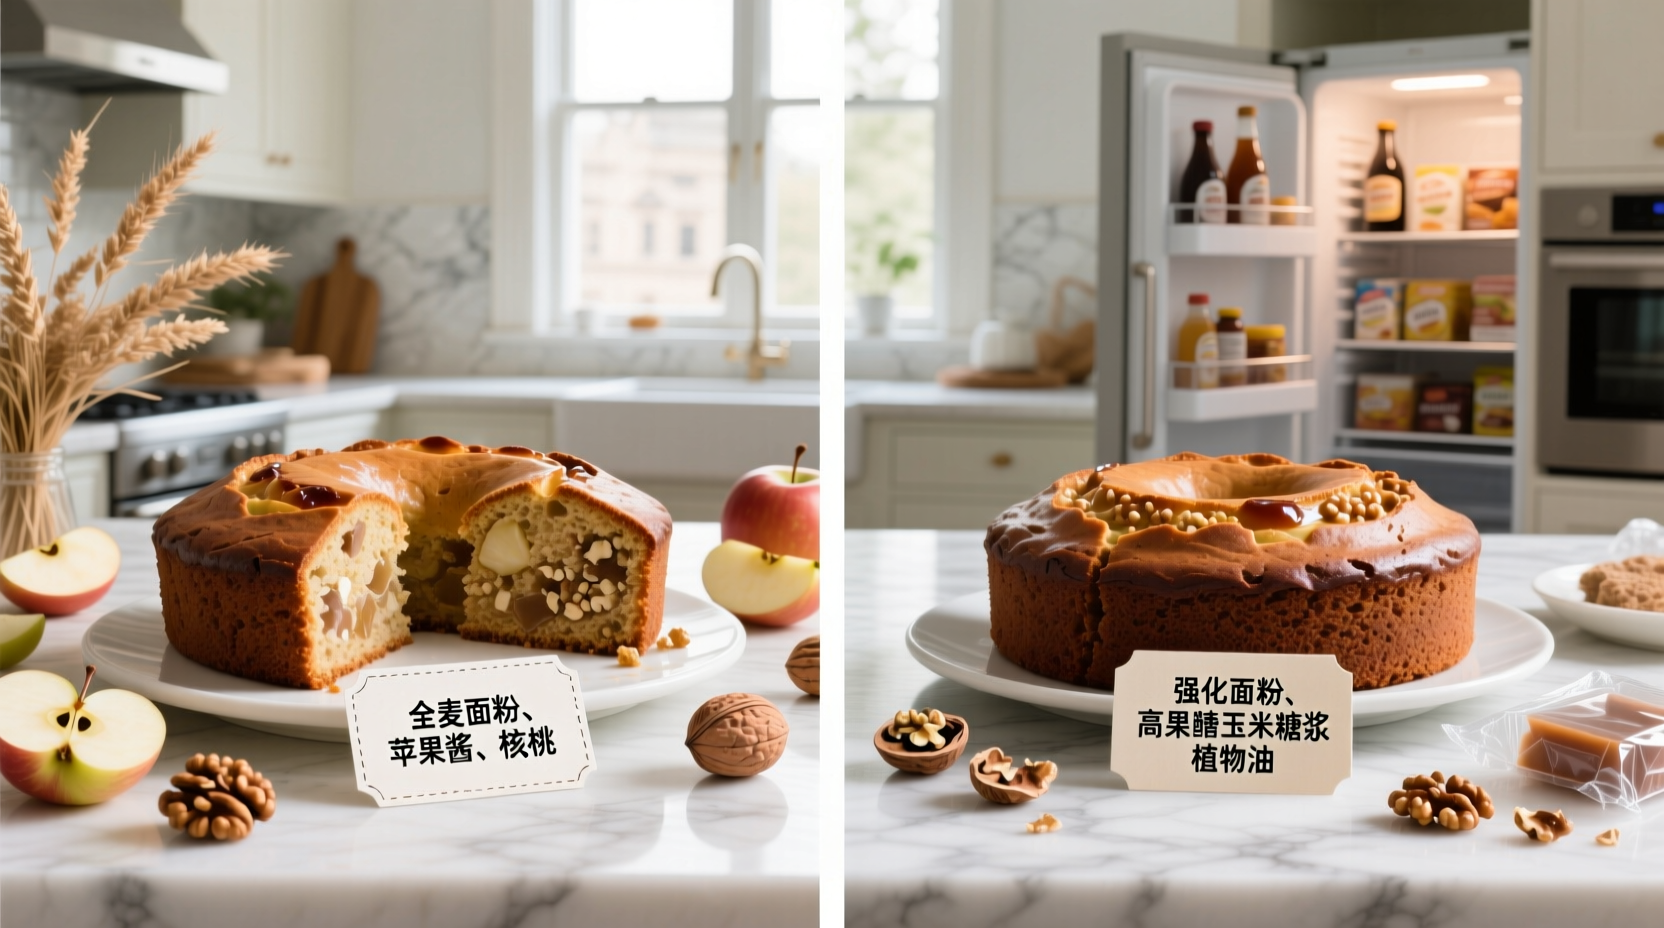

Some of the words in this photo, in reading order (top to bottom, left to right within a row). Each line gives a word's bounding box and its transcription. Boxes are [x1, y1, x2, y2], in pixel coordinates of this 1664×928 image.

[1174, 676, 1294, 706] 强化面粉、
[408, 694, 533, 730] 全麦面粉、
[1191, 743, 1274, 774] 植物油
